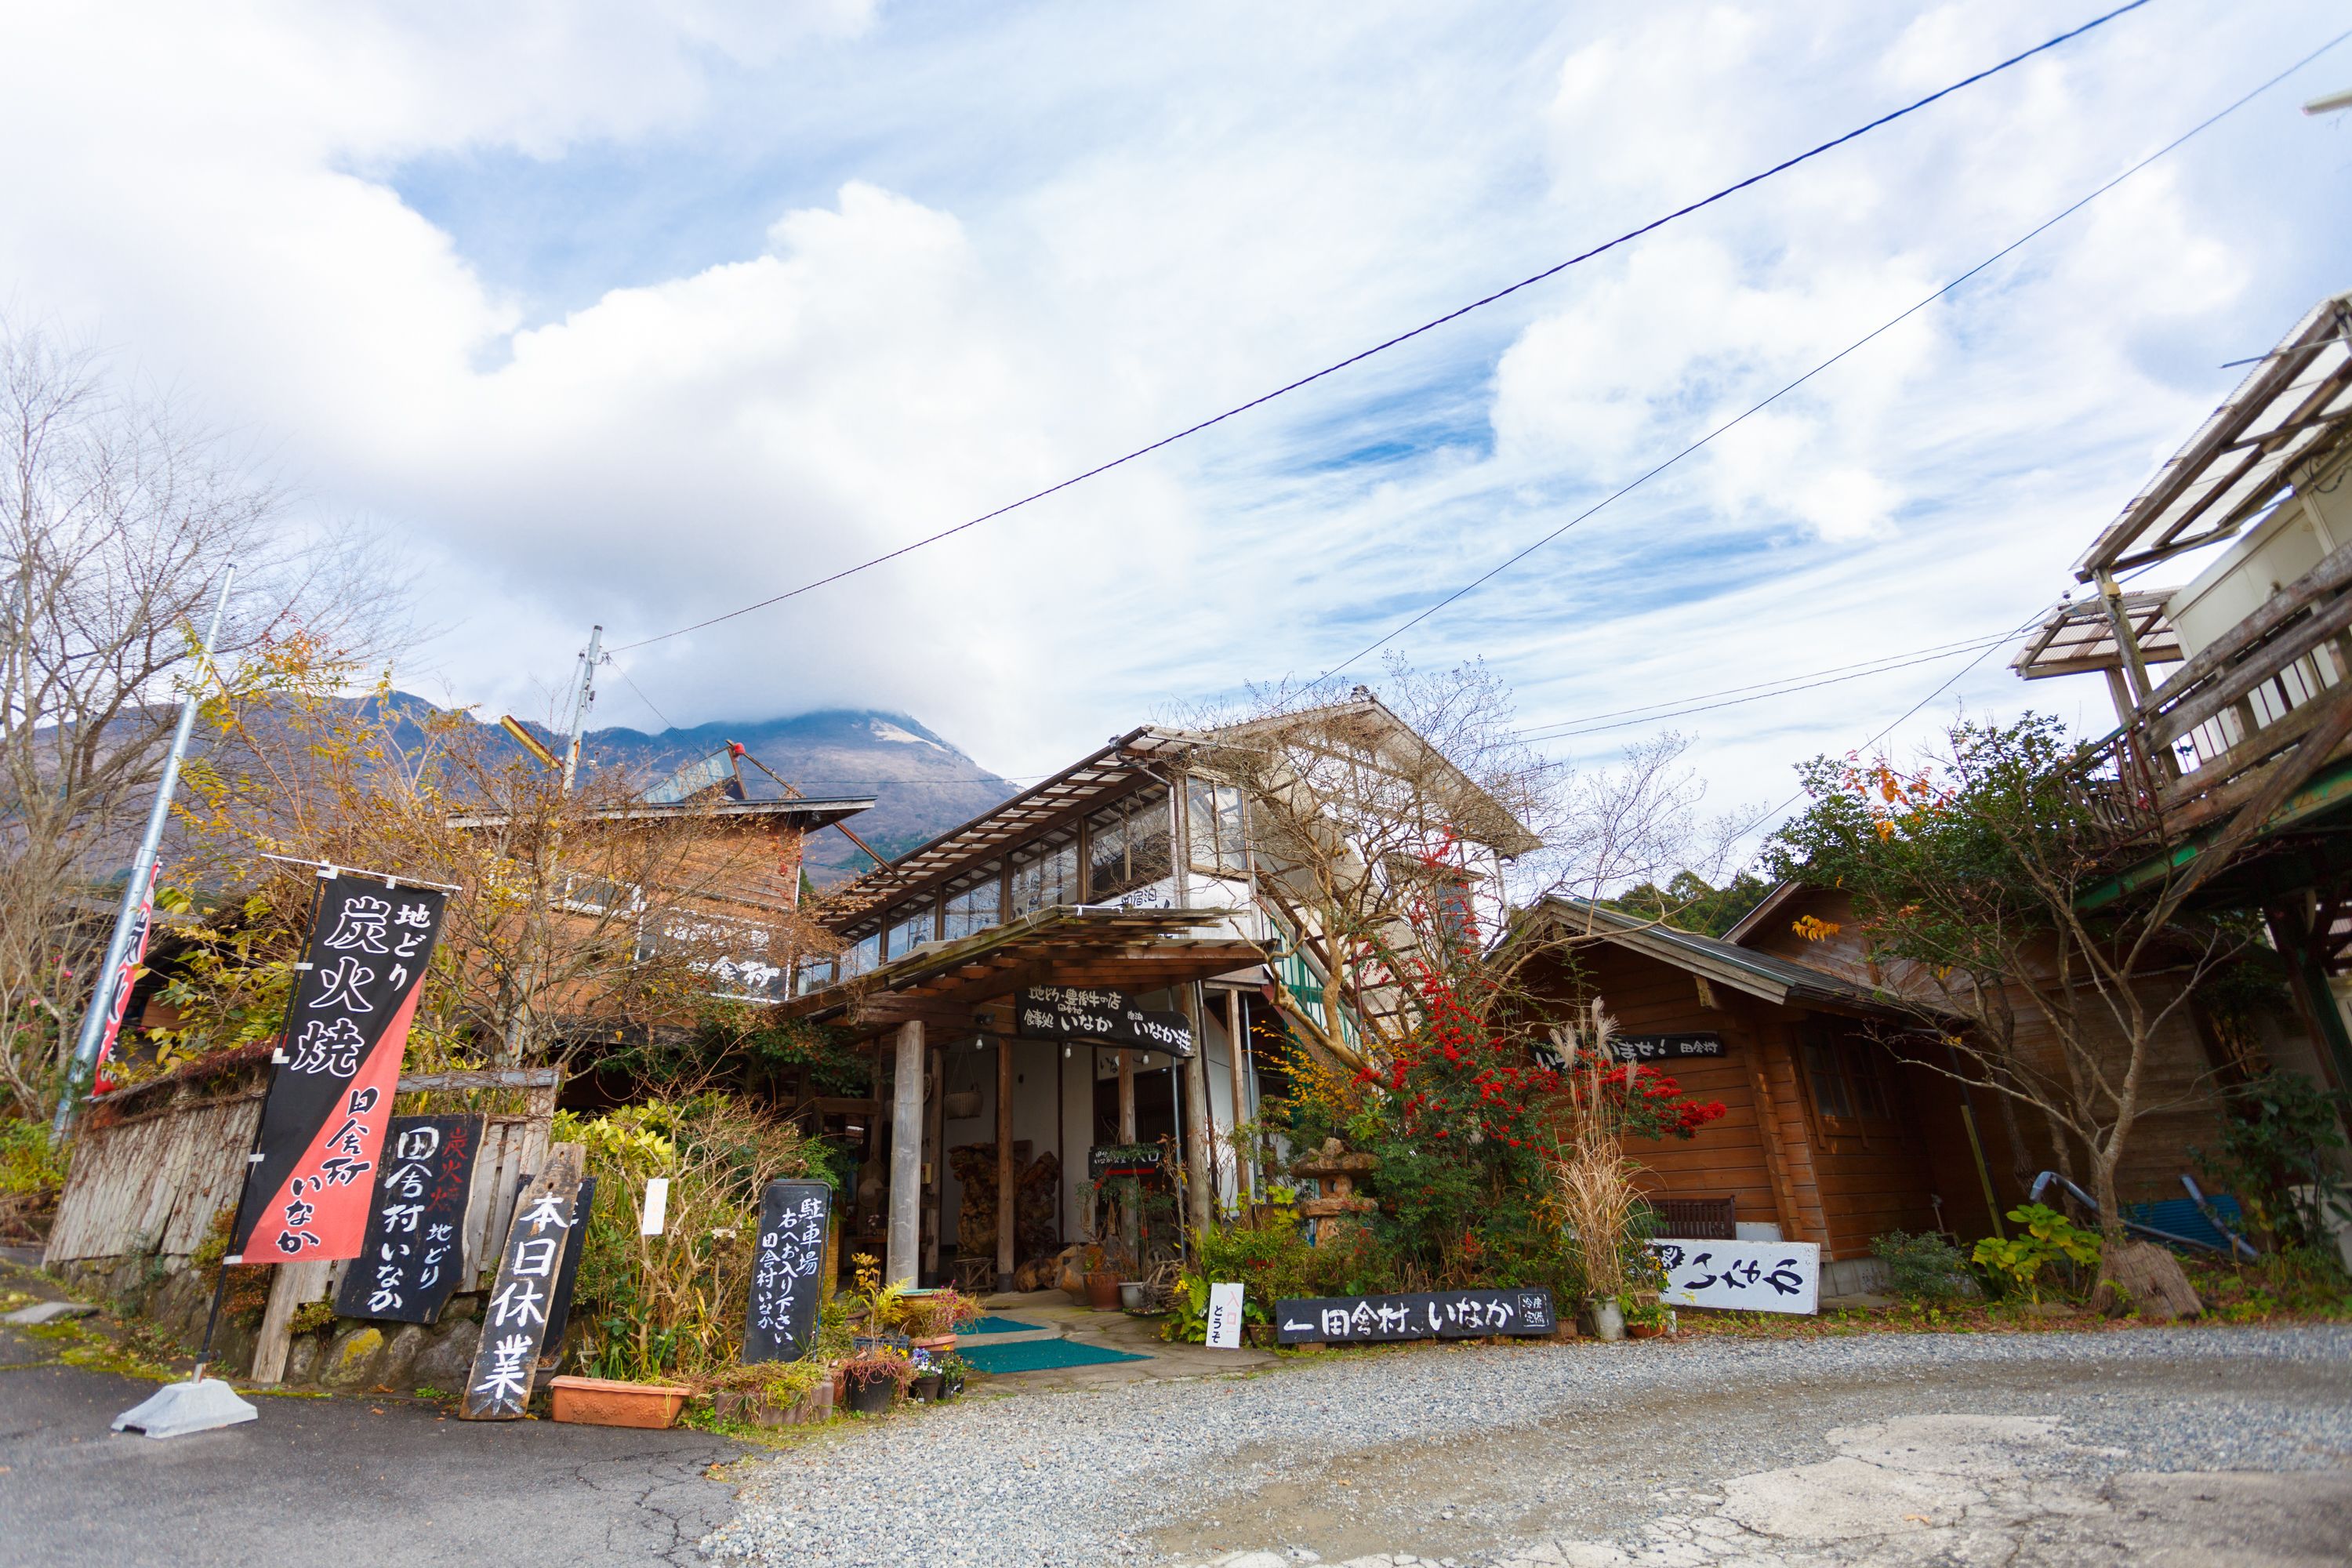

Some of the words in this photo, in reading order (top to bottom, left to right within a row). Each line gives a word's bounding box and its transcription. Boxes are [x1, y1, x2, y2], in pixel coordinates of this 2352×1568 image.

[291, 895, 392, 1077] 炭火焼
[389, 903, 430, 991] 地どり
[1024, 1008, 1054, 1028] 食事処
[1061, 1014, 1113, 1033] いなか
[1134, 1021, 1192, 1051] いなか荘
[1680, 1040, 1719, 1054] 田舎村
[321, 1086, 379, 1186] 田舎村
[276, 1175, 323, 1254] いなか
[796, 1197, 825, 1277] 駐車場
[420, 1222, 454, 1290] 地どり
[775, 1208, 800, 1344] 右へお入り下さい
[1683, 1253, 1803, 1296] いなか
[474, 1192, 569, 1401] 本日休業
[1211, 1305, 1224, 1344] どうぞ
